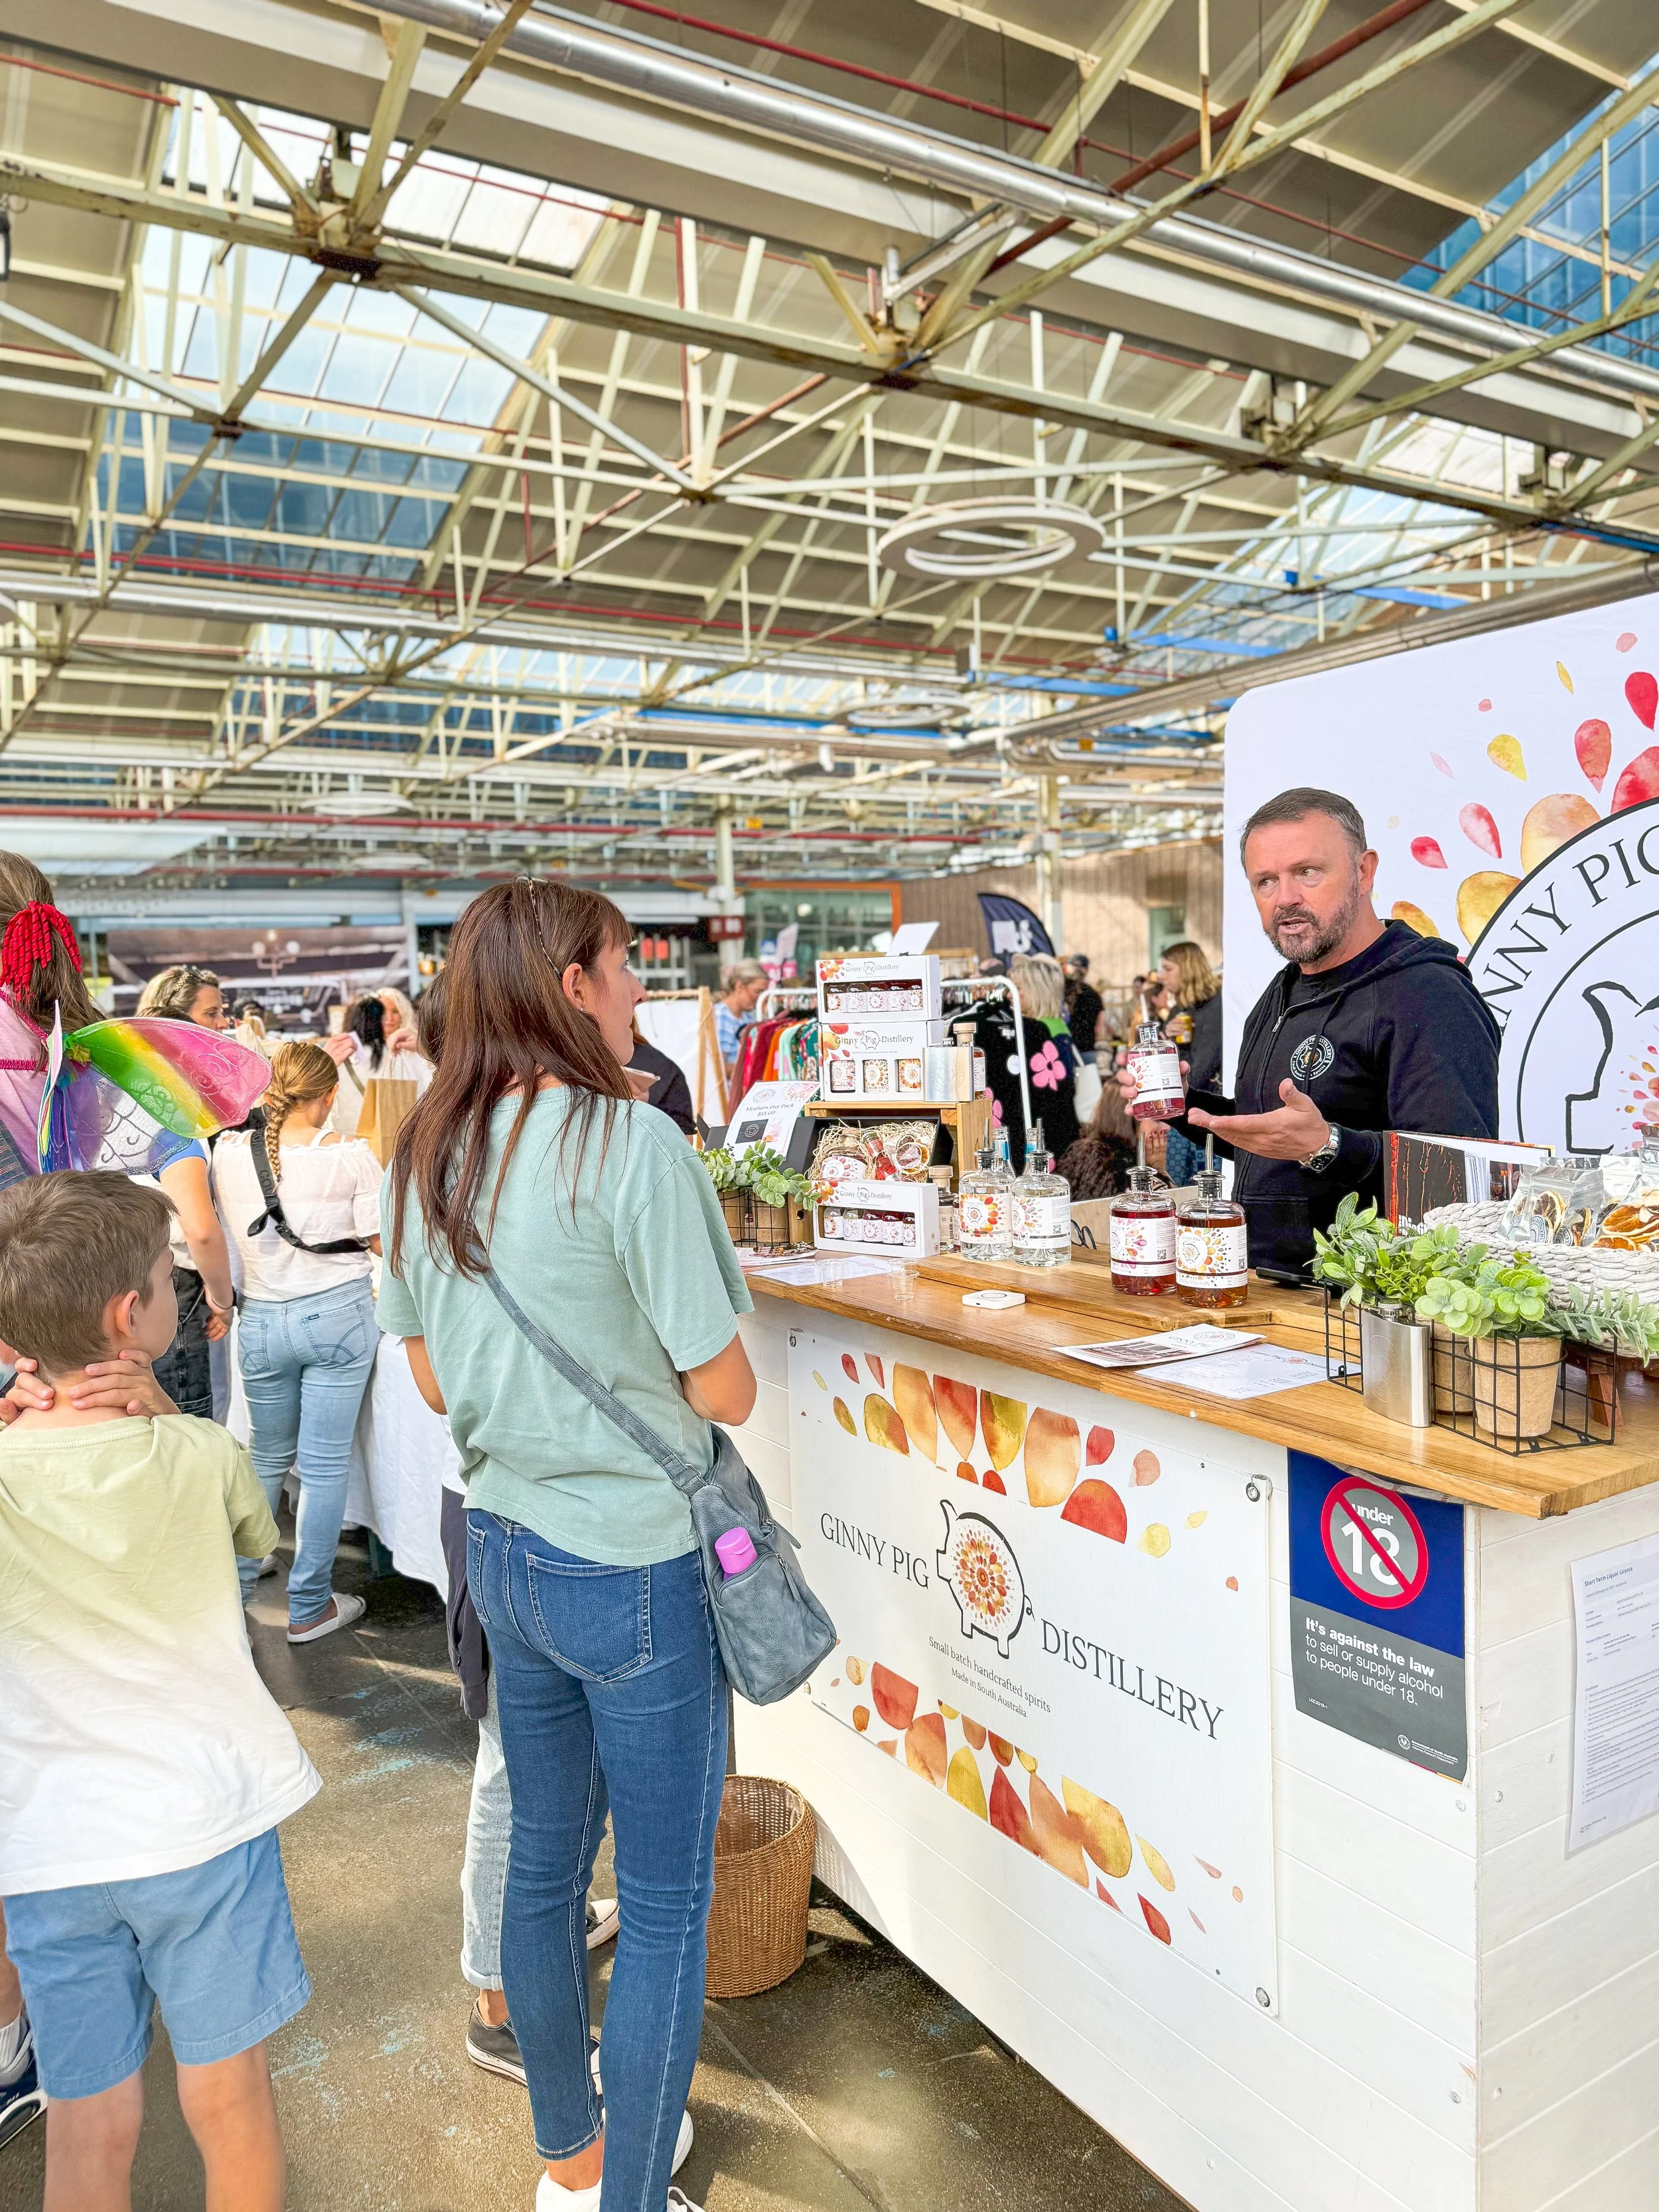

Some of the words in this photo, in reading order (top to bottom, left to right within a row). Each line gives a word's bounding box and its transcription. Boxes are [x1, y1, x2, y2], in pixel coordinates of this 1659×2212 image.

[1480, 881, 1571, 1036] NNY
[865, 1035, 877, 1045] Pig
[881, 1035, 914, 1044] Distillery
[1352, 1504, 1394, 1526] under
[1341, 1520, 1401, 1585] 18
[1607, 1571, 1619, 1580] Liquor
[1619, 1566, 1633, 1575] Licence
[820, 1512, 887, 1567] GINNY
[892, 1544, 930, 1589] PIG
[1041, 1619, 1224, 1741] DISTILLERY
[1305, 1617, 1326, 1635] It's
[1329, 1630, 1378, 1657] against
[1382, 1647, 1405, 1666] the
[1409, 1657, 1435, 1678] law
[929, 1636, 950, 1657] Small
[950, 1647, 973, 1670] batch
[974, 1659, 1023, 1697] handcrafted
[1024, 1691, 1051, 1713] spirits
[952, 1668, 970, 1684] Made
[970, 1676, 977, 1688] in
[977, 1680, 997, 1700] South
[997, 1694, 1027, 1718] Australia
[1305, 1633, 1317, 1649] to
[1320, 1642, 1338, 1657] sell
[1341, 1650, 1353, 1662] or
[1356, 1655, 1396, 1680] supply
[1399, 1672, 1443, 1698] alcohol
[1305, 1650, 1317, 1664] to
[1320, 1657, 1358, 1680] people
[1362, 1674, 1396, 1696] under
[1400, 1688, 1418, 1706] 18.
